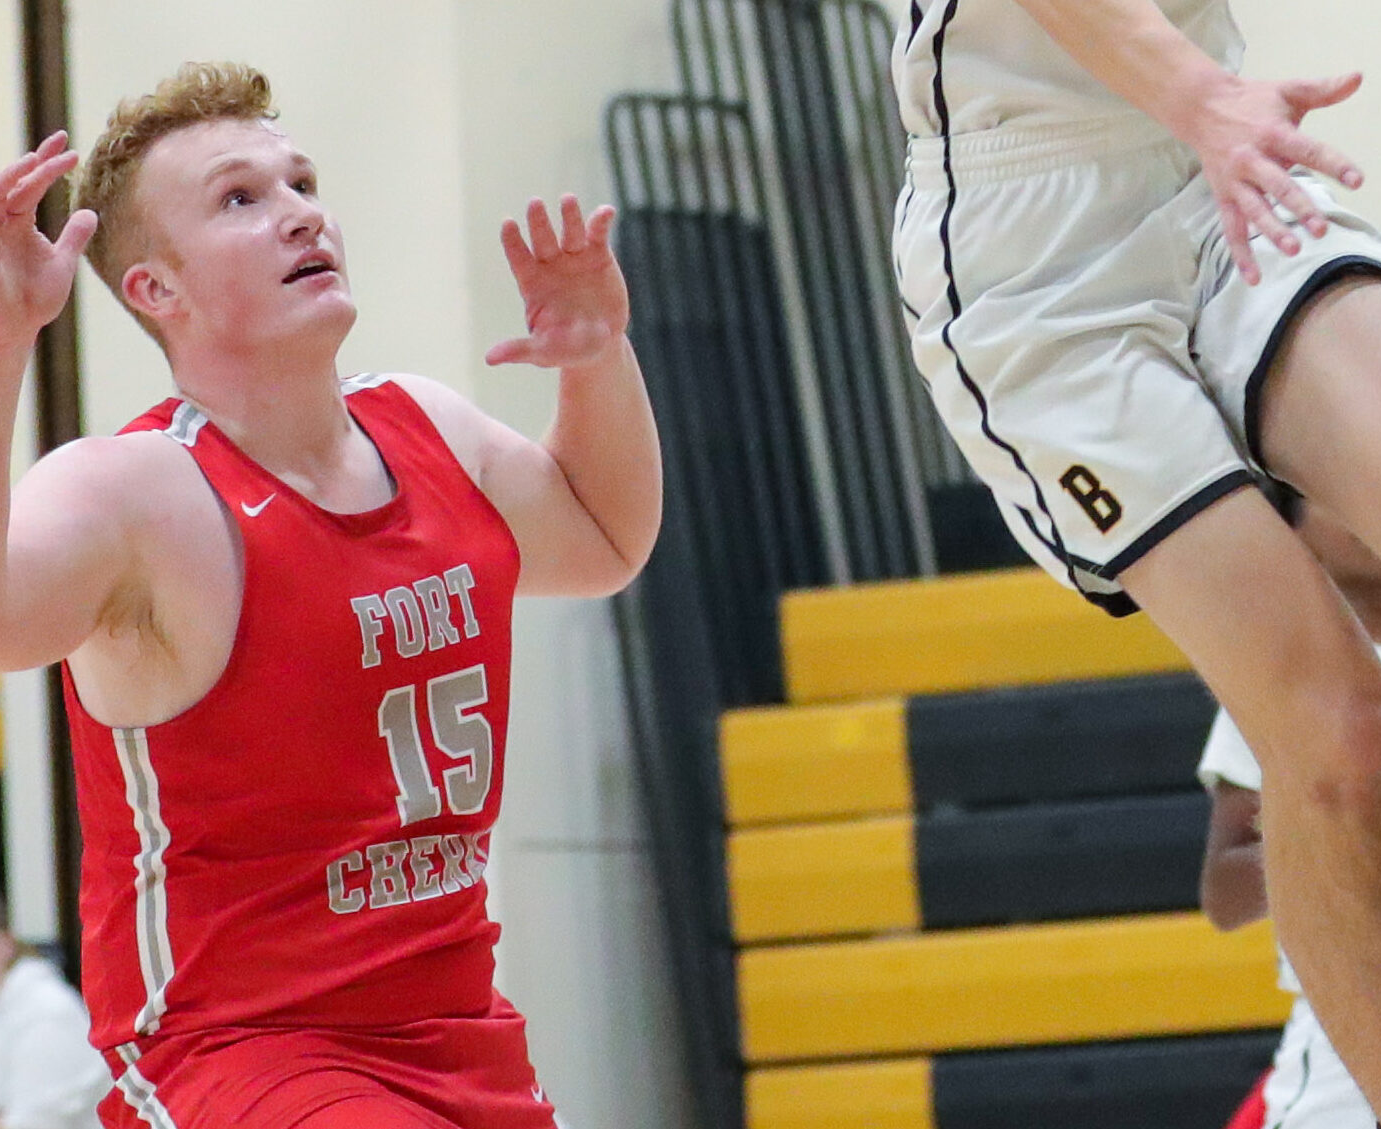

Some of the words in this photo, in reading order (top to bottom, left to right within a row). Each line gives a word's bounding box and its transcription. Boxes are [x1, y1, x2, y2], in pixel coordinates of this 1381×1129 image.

[1058, 464, 1123, 535] B
[350, 563, 481, 669] FORT
[378, 663, 493, 827] 15
